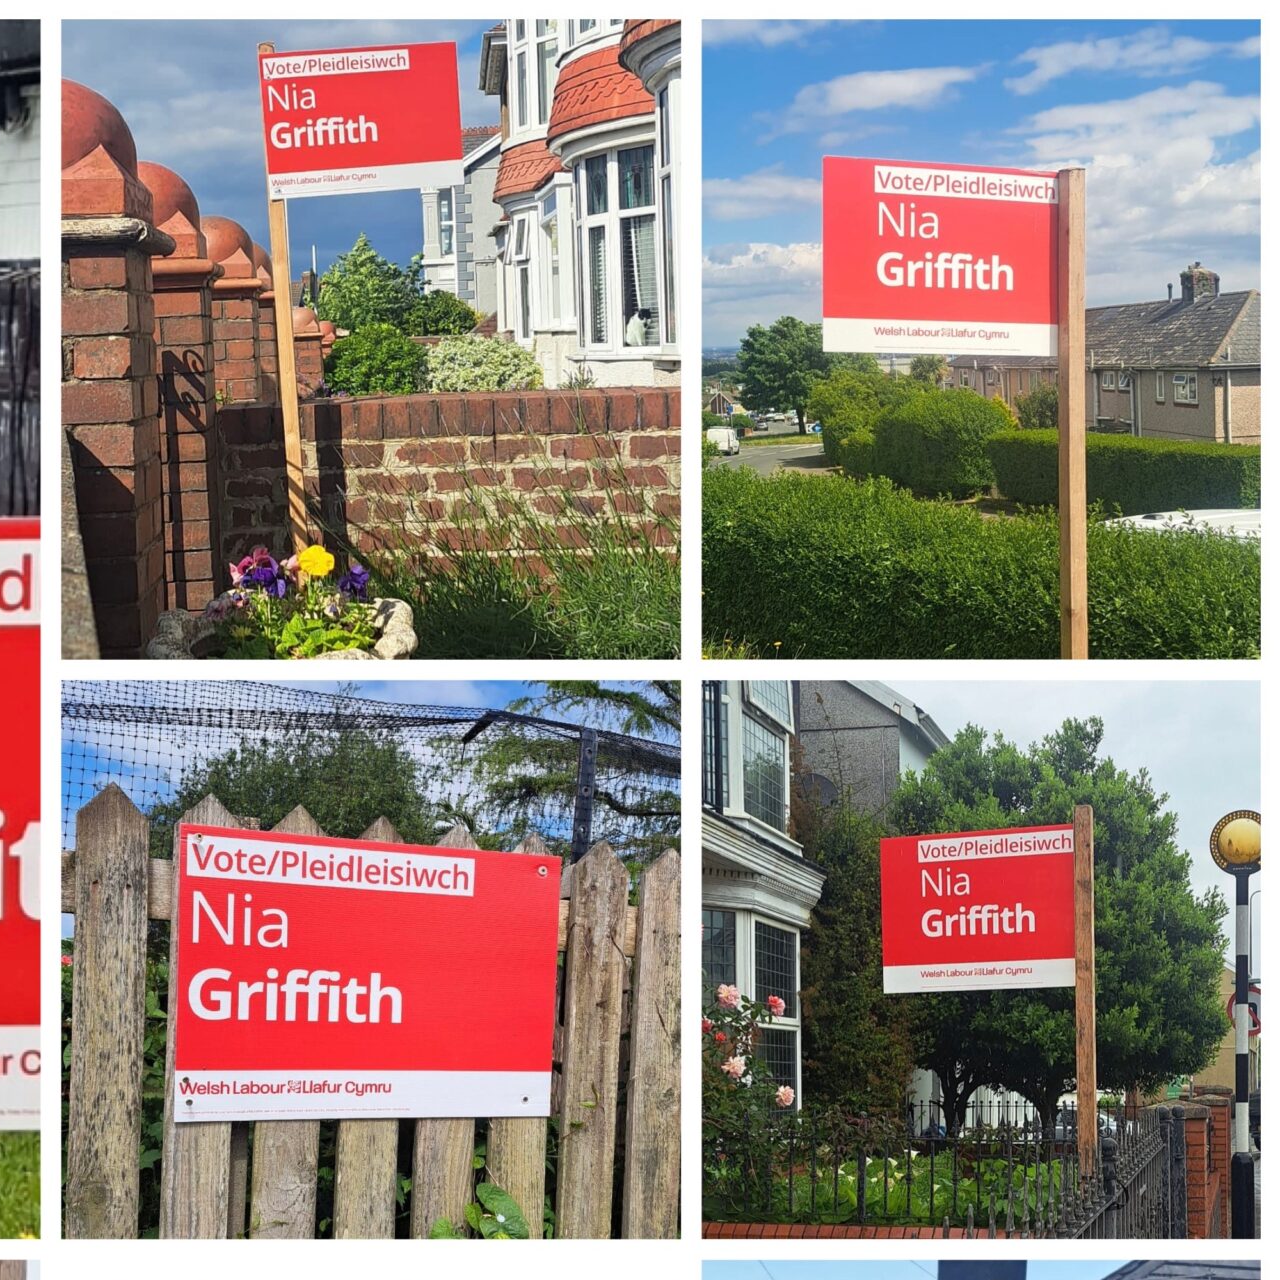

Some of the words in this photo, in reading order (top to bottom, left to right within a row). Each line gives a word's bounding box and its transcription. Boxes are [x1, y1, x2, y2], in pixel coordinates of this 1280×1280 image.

[265, 53, 406, 76] Vote/Pleidleisiwch
[267, 83, 317, 112] Nia
[270, 115, 378, 149] Griffith
[877, 170, 1056, 200] Vote/Pleidleisiwch
[878, 201, 939, 239] Nia
[876, 251, 1014, 291] Griffith
[874, 326, 906, 337] Welsh
[907, 327, 940, 337] Labour
[951, 327, 977, 338] Llafur
[978, 329, 1010, 341] Cymru
[920, 833, 1072, 859] Vote/Pleidleisiwch
[192, 843, 469, 891] Vote/Pleidleisiwch
[921, 867, 970, 898] Nia
[191, 890, 289, 948] Nia
[921, 902, 1036, 938] Griffith
[187, 967, 403, 1025] Griffith
[179, 1080, 230, 1096] Welsh
[233, 1079, 286, 1096] Labour
[301, 1080, 342, 1095] Llafur
[345, 1080, 392, 1097] Cymru
